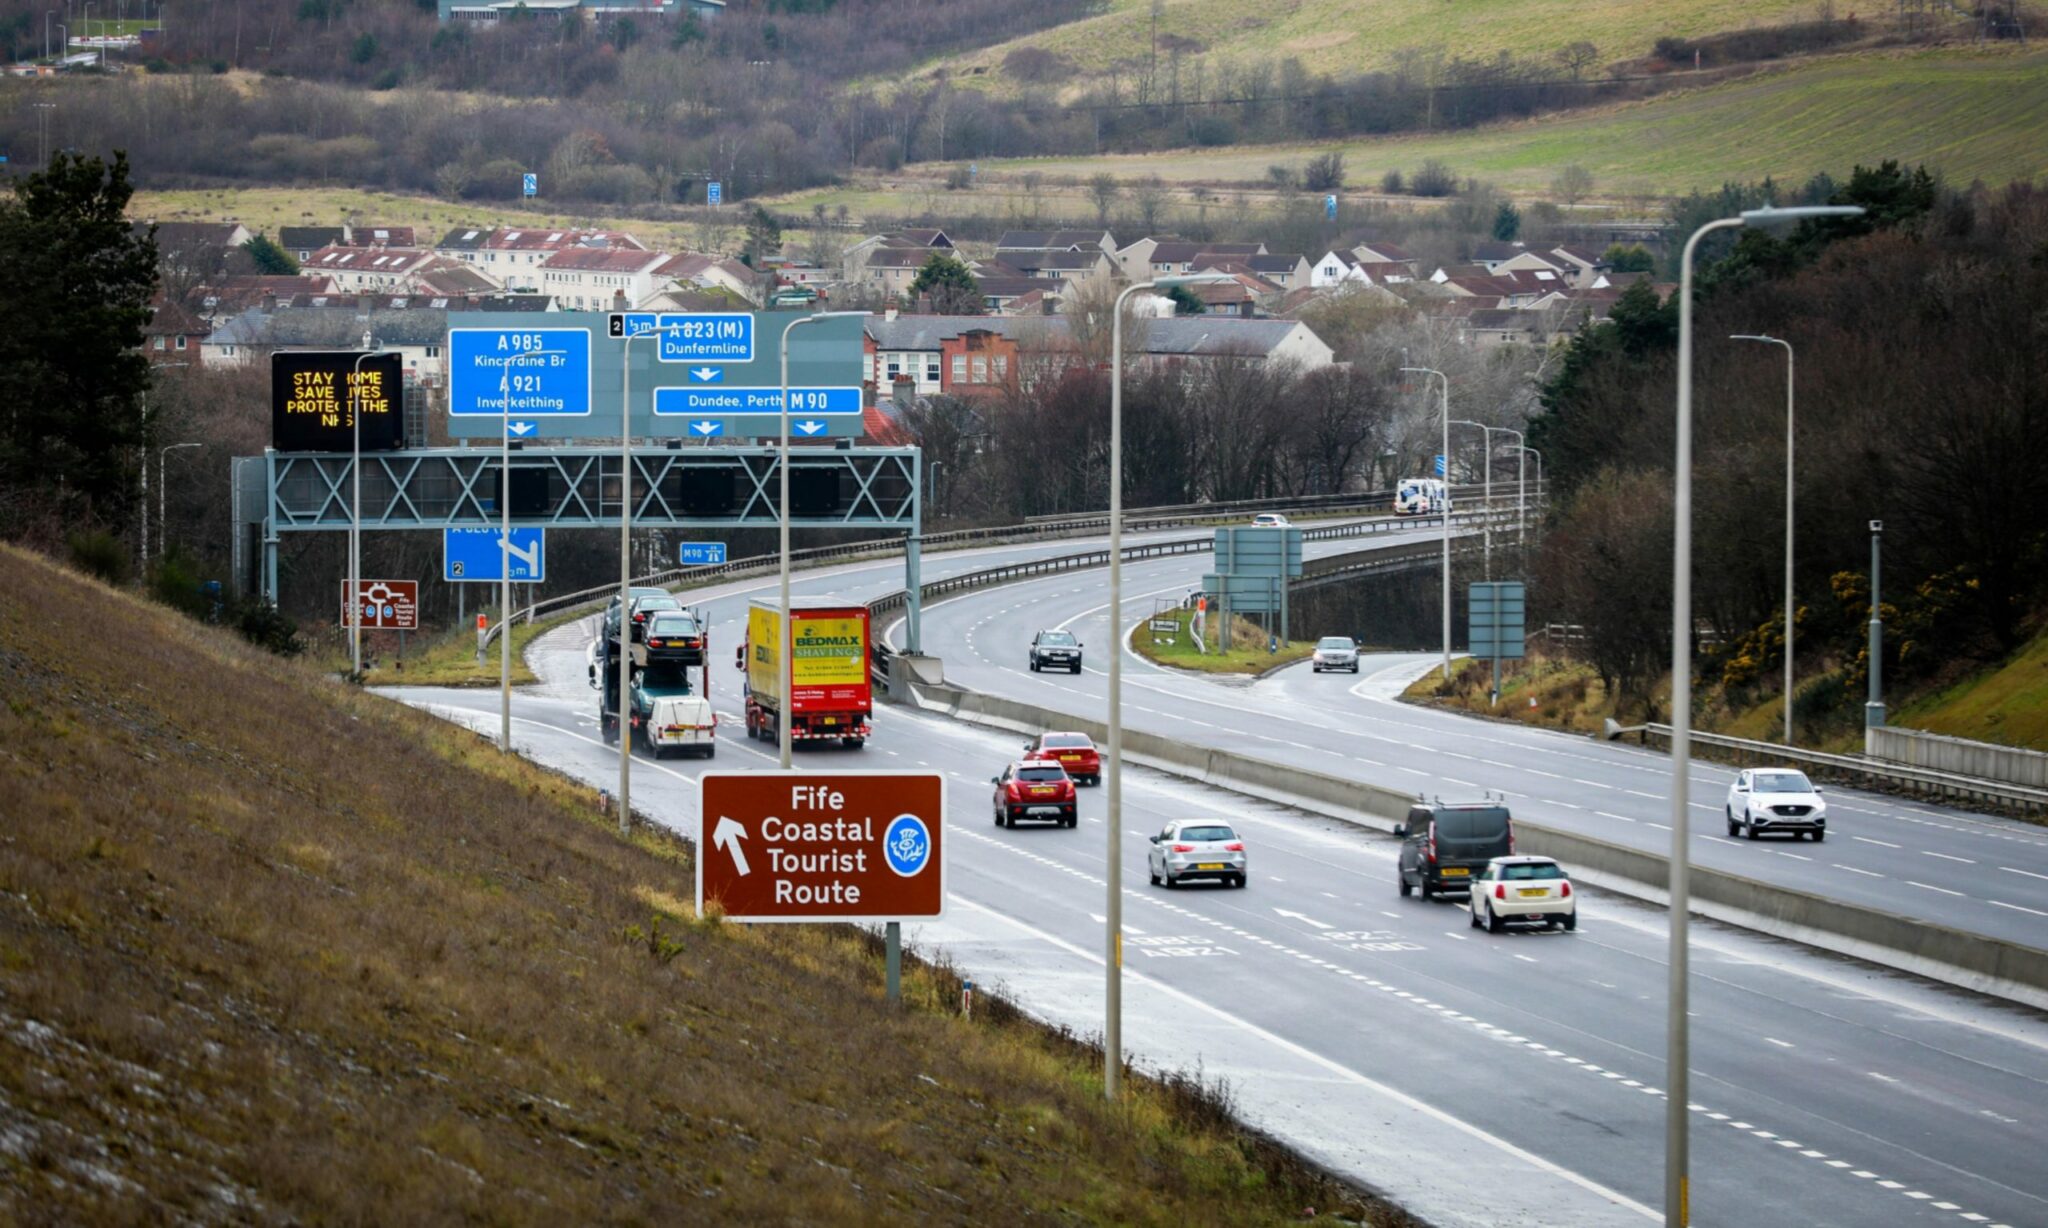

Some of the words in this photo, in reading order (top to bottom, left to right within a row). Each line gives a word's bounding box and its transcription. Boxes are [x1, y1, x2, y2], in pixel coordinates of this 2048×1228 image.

[613, 321, 621, 331] 2
[665, 342, 747, 354] Dunfermline
[550, 355, 566, 367] Br
[293, 371, 335, 385] STAY
[295, 386, 335, 399] SAVE
[346, 386, 381, 399] IVES
[360, 399, 389, 413] THE
[747, 394, 783, 407] Perth
[454, 563, 462, 575] 2
[795, 636, 860, 646] BEDMAX
[796, 647, 860, 657] SHAVINGS
[792, 785, 845, 810] Fife
[761, 816, 874, 842] Coastal
[766, 848, 867, 873] Tourist
[775, 879, 860, 904] Route
